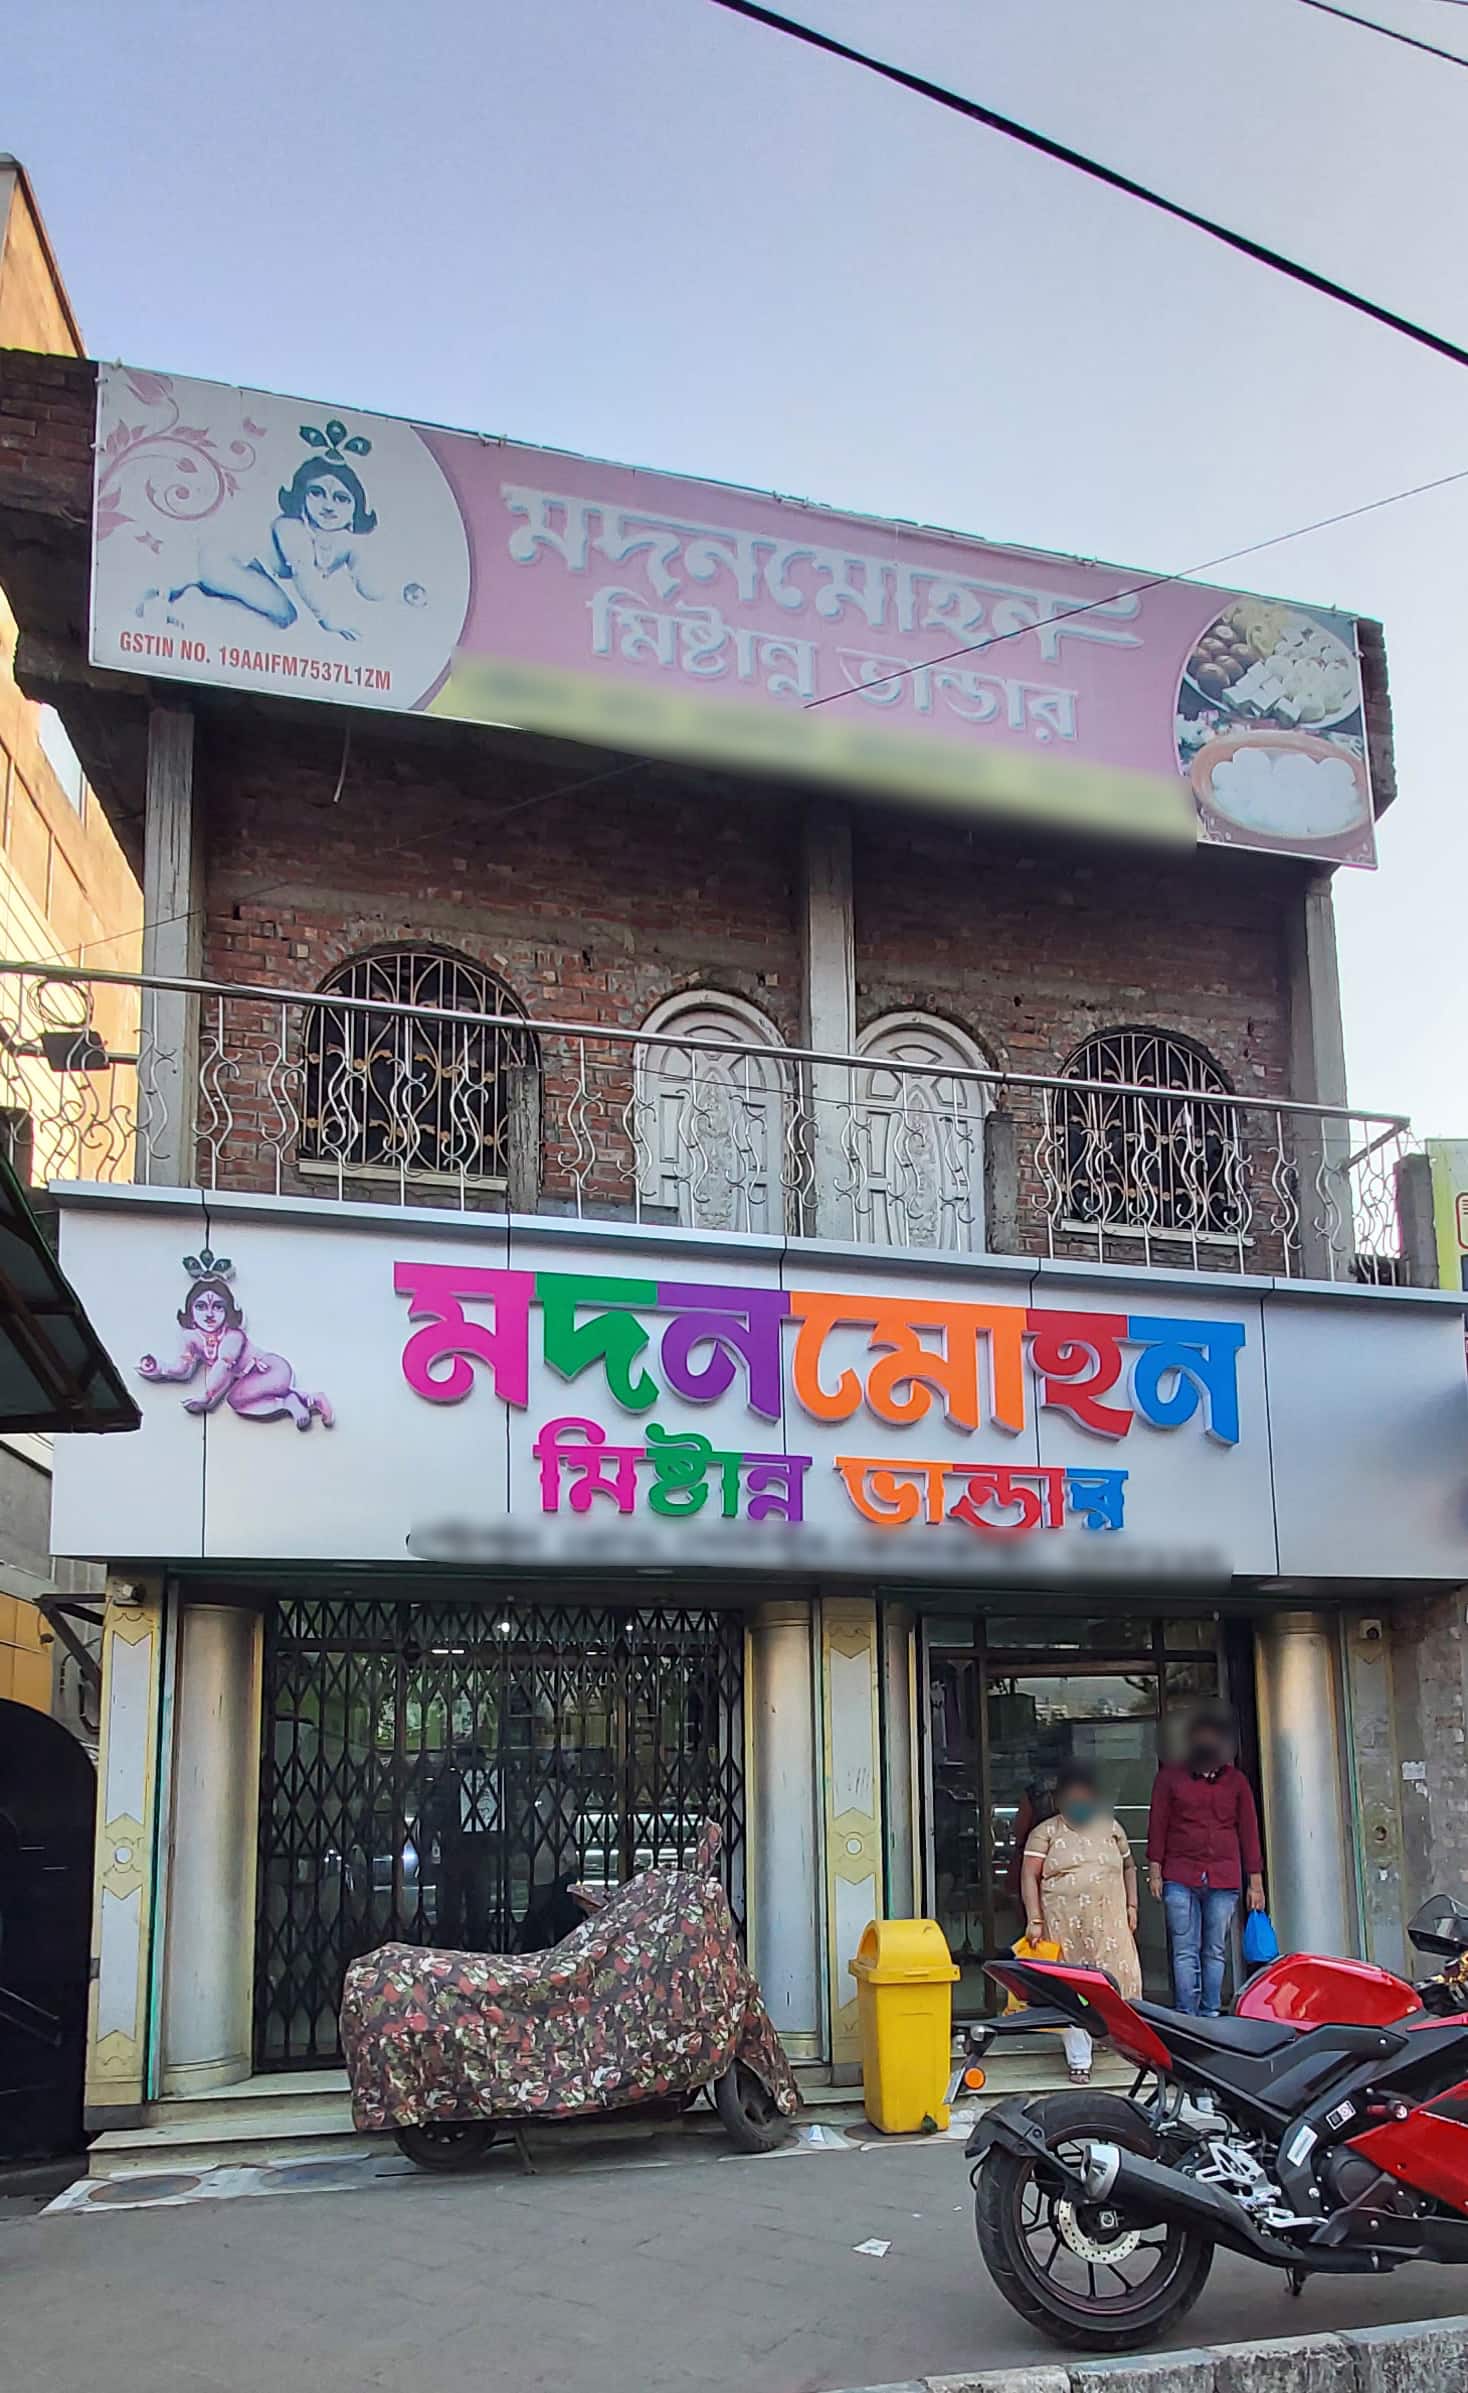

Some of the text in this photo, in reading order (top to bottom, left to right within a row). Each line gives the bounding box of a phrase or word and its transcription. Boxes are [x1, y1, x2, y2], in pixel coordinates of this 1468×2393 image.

[501, 483, 1144, 661] মদনমোহন
[120, 631, 392, 690] GSTIN NO. 19AAIFM7537L1ZM
[585, 586, 817, 700] মিষ্টান্ন
[394, 1260, 1247, 1446] মদনমোহন
[532, 1416, 813, 1522] মিষ্টান্ন
